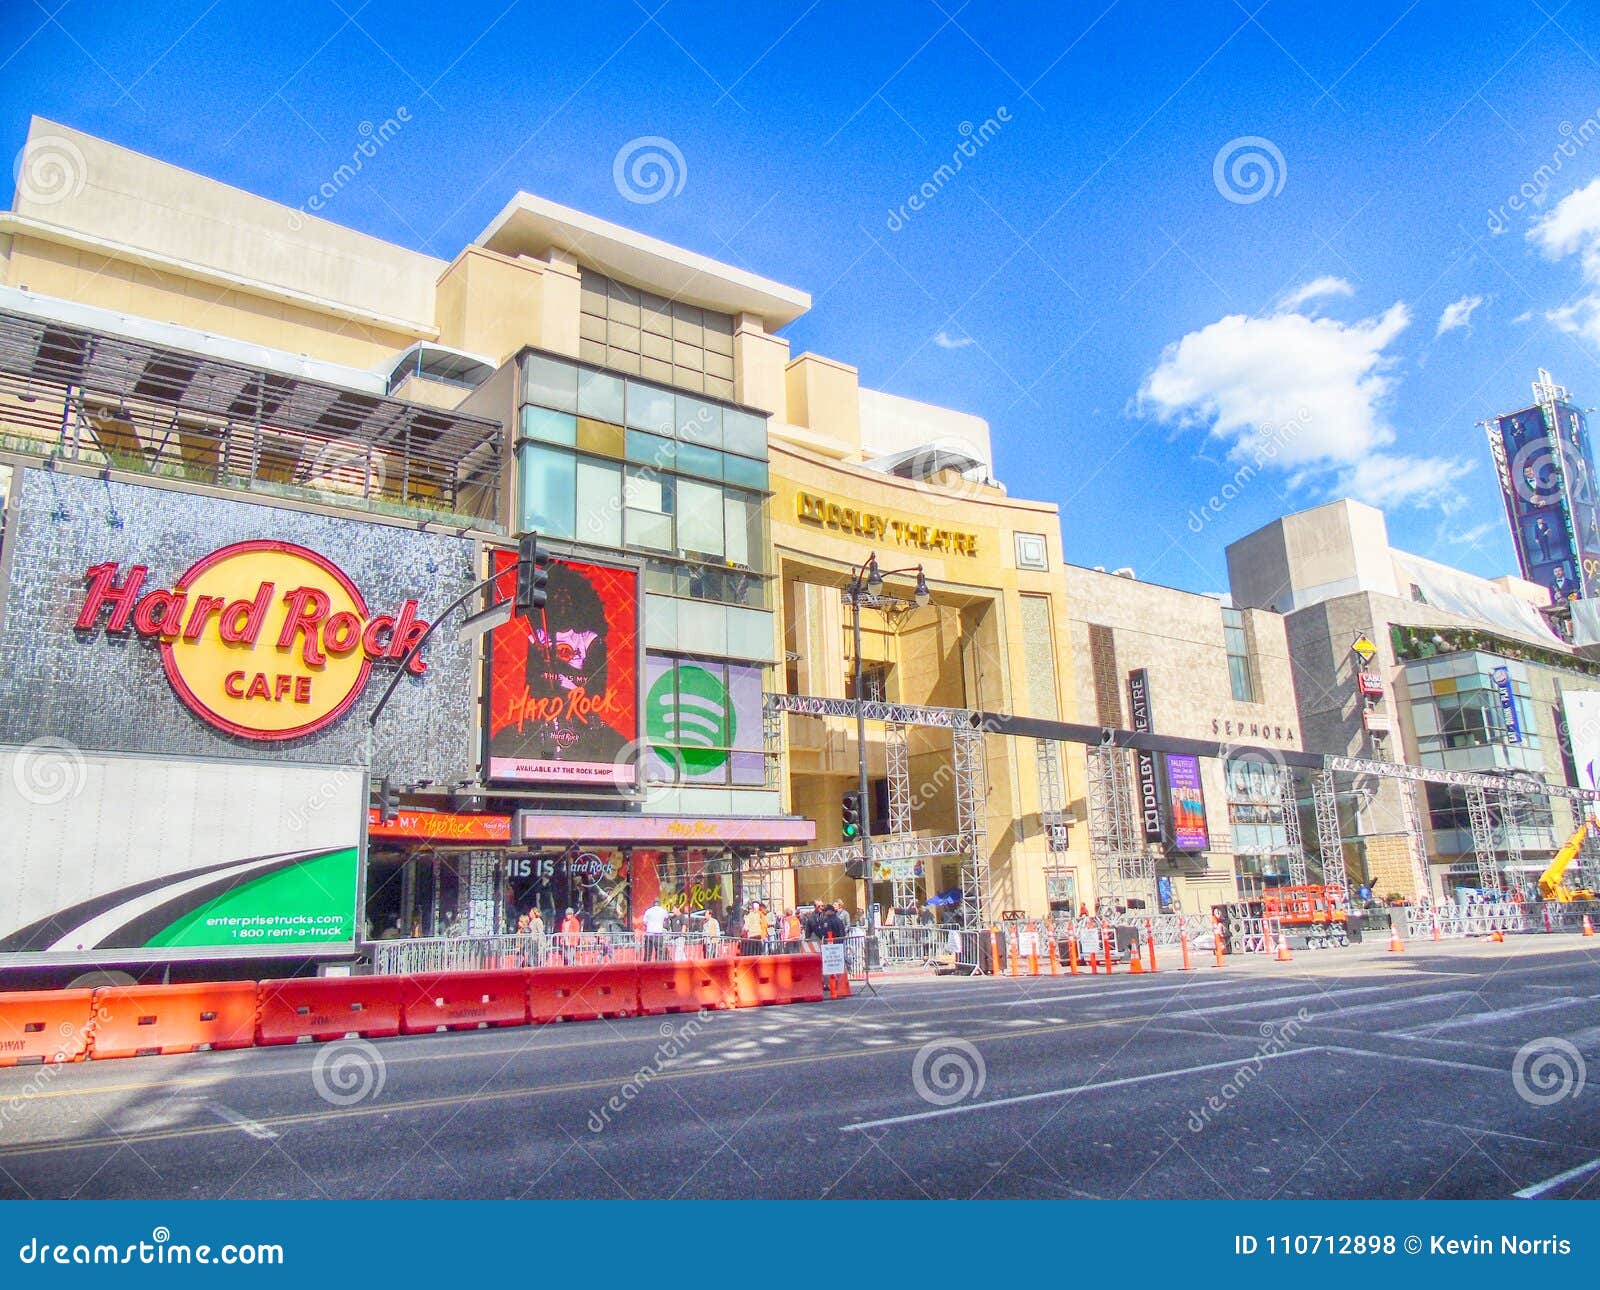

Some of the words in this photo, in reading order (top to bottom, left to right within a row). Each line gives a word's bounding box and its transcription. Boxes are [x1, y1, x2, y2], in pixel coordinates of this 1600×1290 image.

[826, 502, 888, 540] DOLBY
[892, 519, 977, 554] THEATRE
[75, 561, 275, 645] Hard
[276, 586, 431, 675] Rock
[224, 670, 312, 704] CAFE
[508, 684, 563, 733] HARD
[565, 686, 620, 725] ROCK
[1131, 679, 1148, 733] EATRE
[1211, 718, 1294, 741] SEPHORA
[516, 765, 551, 773] AVAILABLE
[576, 767, 593, 775] ROCK
[1140, 754, 1157, 808] DOLBY
[400, 817, 418, 829] MY
[537, 859, 554, 877] IS
[206, 914, 344, 928] enterprisetrucks.com
[231, 929, 237, 937] 1
[240, 928, 264, 937] 800
[267, 925, 342, 937] rent-a-truck
